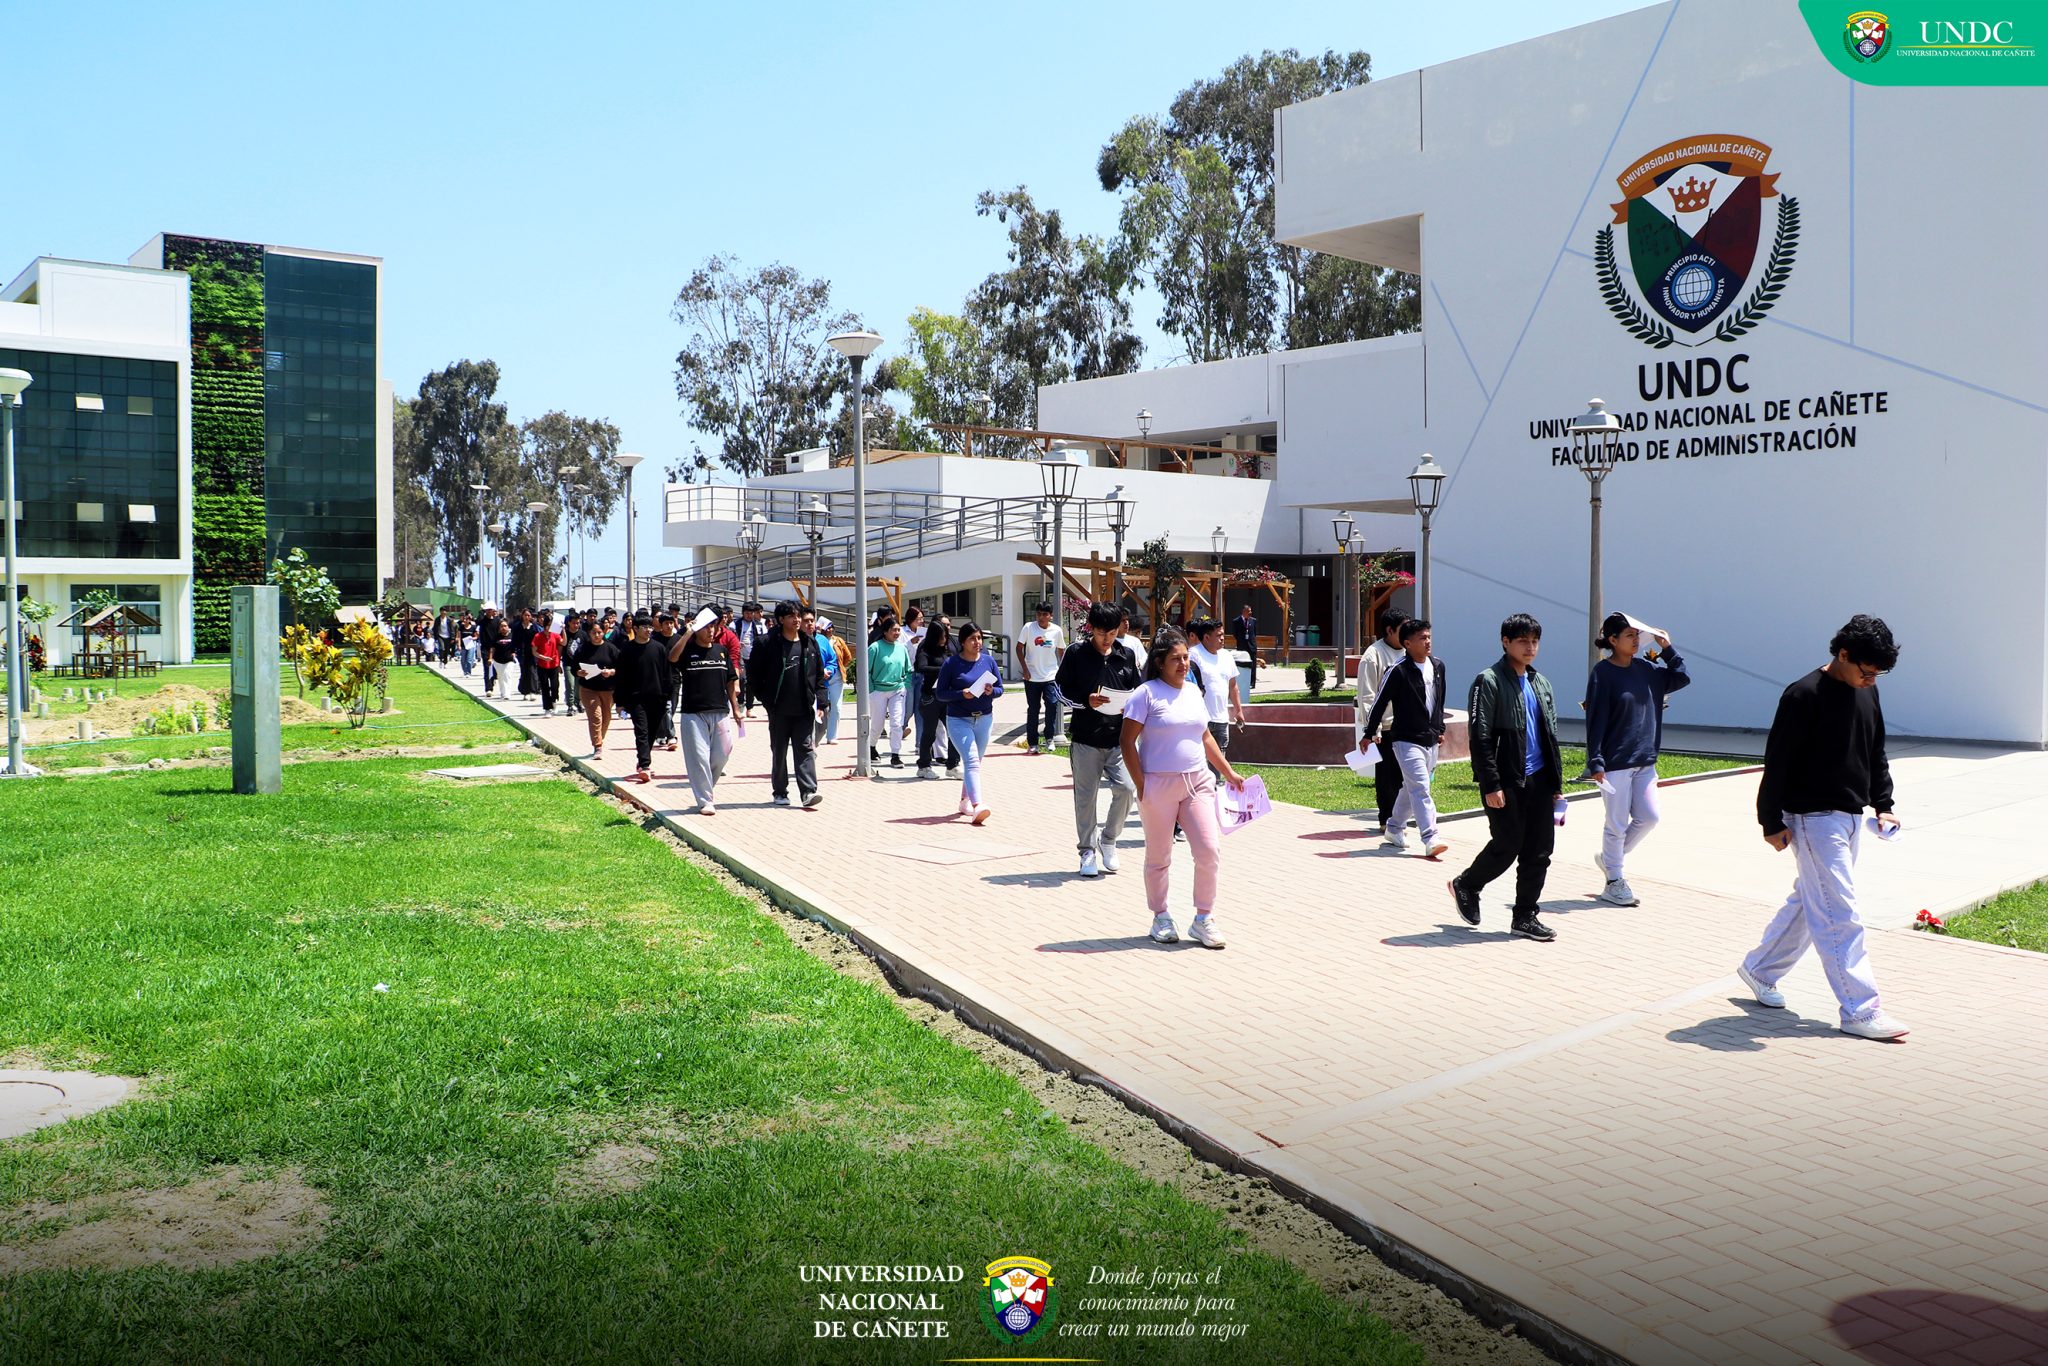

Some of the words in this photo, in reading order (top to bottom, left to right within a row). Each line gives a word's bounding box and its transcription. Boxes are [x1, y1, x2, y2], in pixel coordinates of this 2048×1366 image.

[1622, 151, 1675, 188] UNIVERSIDAD
[1676, 144, 1718, 159] NACIONAL
[1720, 143, 1732, 153] DE
[1732, 144, 1766, 162] CAÑETE
[1665, 254, 1698, 281] PRINCIPIO
[1698, 254, 1716, 267] ACTI
[1662, 286, 1690, 320] INNOVADOR
[1697, 277, 1725, 318] HUMANISTA
[1639, 354, 1750, 401] UNDC
[1655, 403, 1756, 430] NACIONAL
[1764, 400, 1791, 422] DE
[1798, 390, 1888, 419] CAÑETE
[1552, 442, 1640, 466] FACULTAD
[1646, 440, 1669, 461] DE
[1675, 422, 1857, 459] ADMINISTRACIÓN
[1471, 686, 1480, 717] POSITIVE
